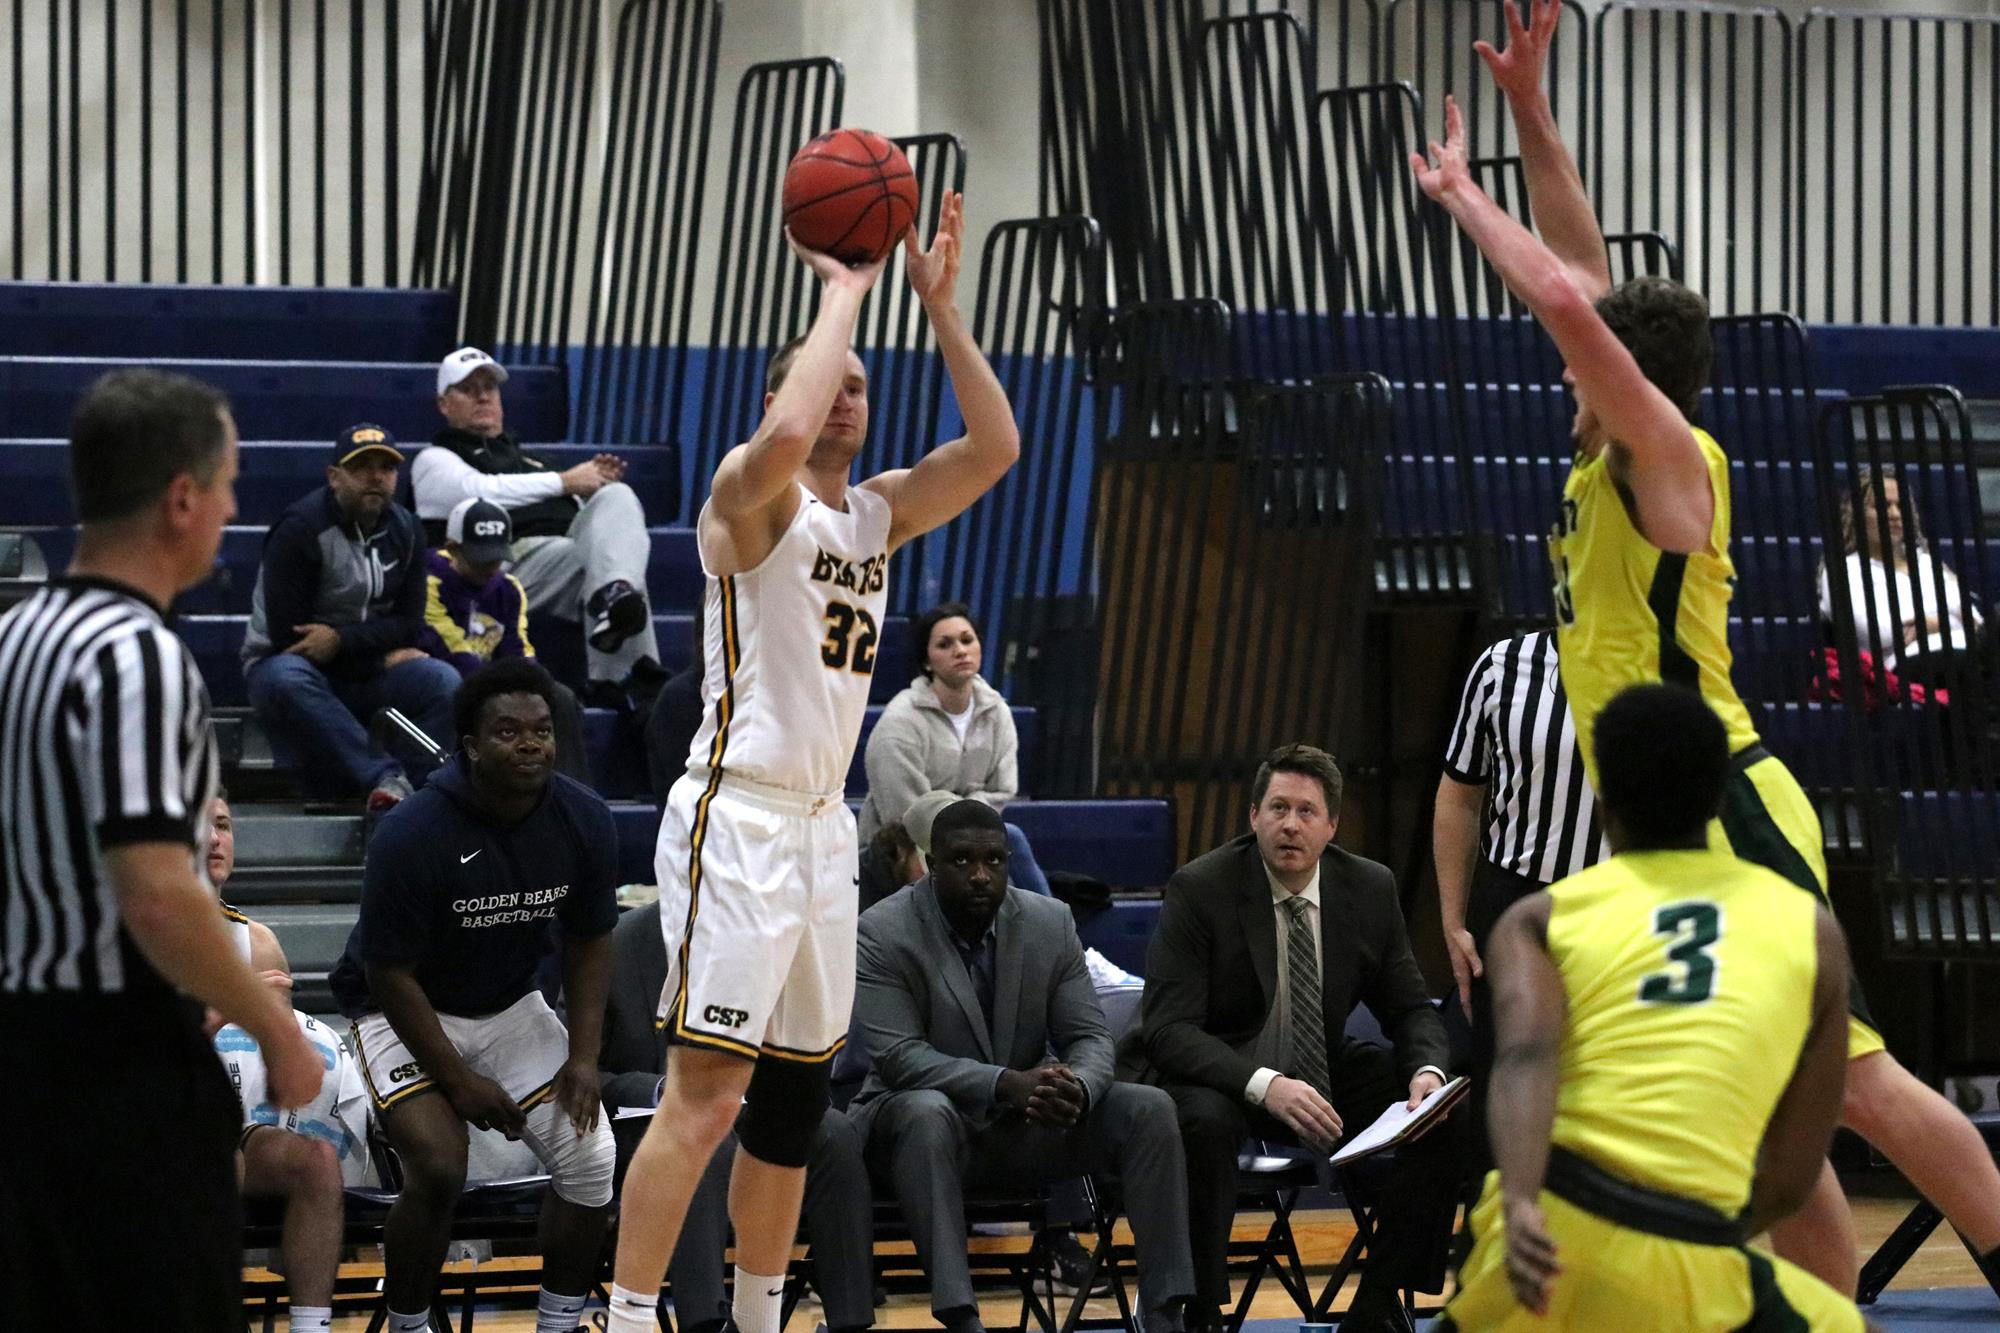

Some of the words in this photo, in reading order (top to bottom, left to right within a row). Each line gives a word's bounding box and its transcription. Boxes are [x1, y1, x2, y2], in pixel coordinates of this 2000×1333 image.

[475, 520, 506, 536] CSP
[820, 600, 878, 674] 32
[452, 892, 520, 913] GOLDEN
[523, 885, 569, 906] BEARS
[461, 907, 556, 928] BASKETBALL
[1637, 899, 1721, 1005] 3
[704, 1004, 749, 1028] CSP
